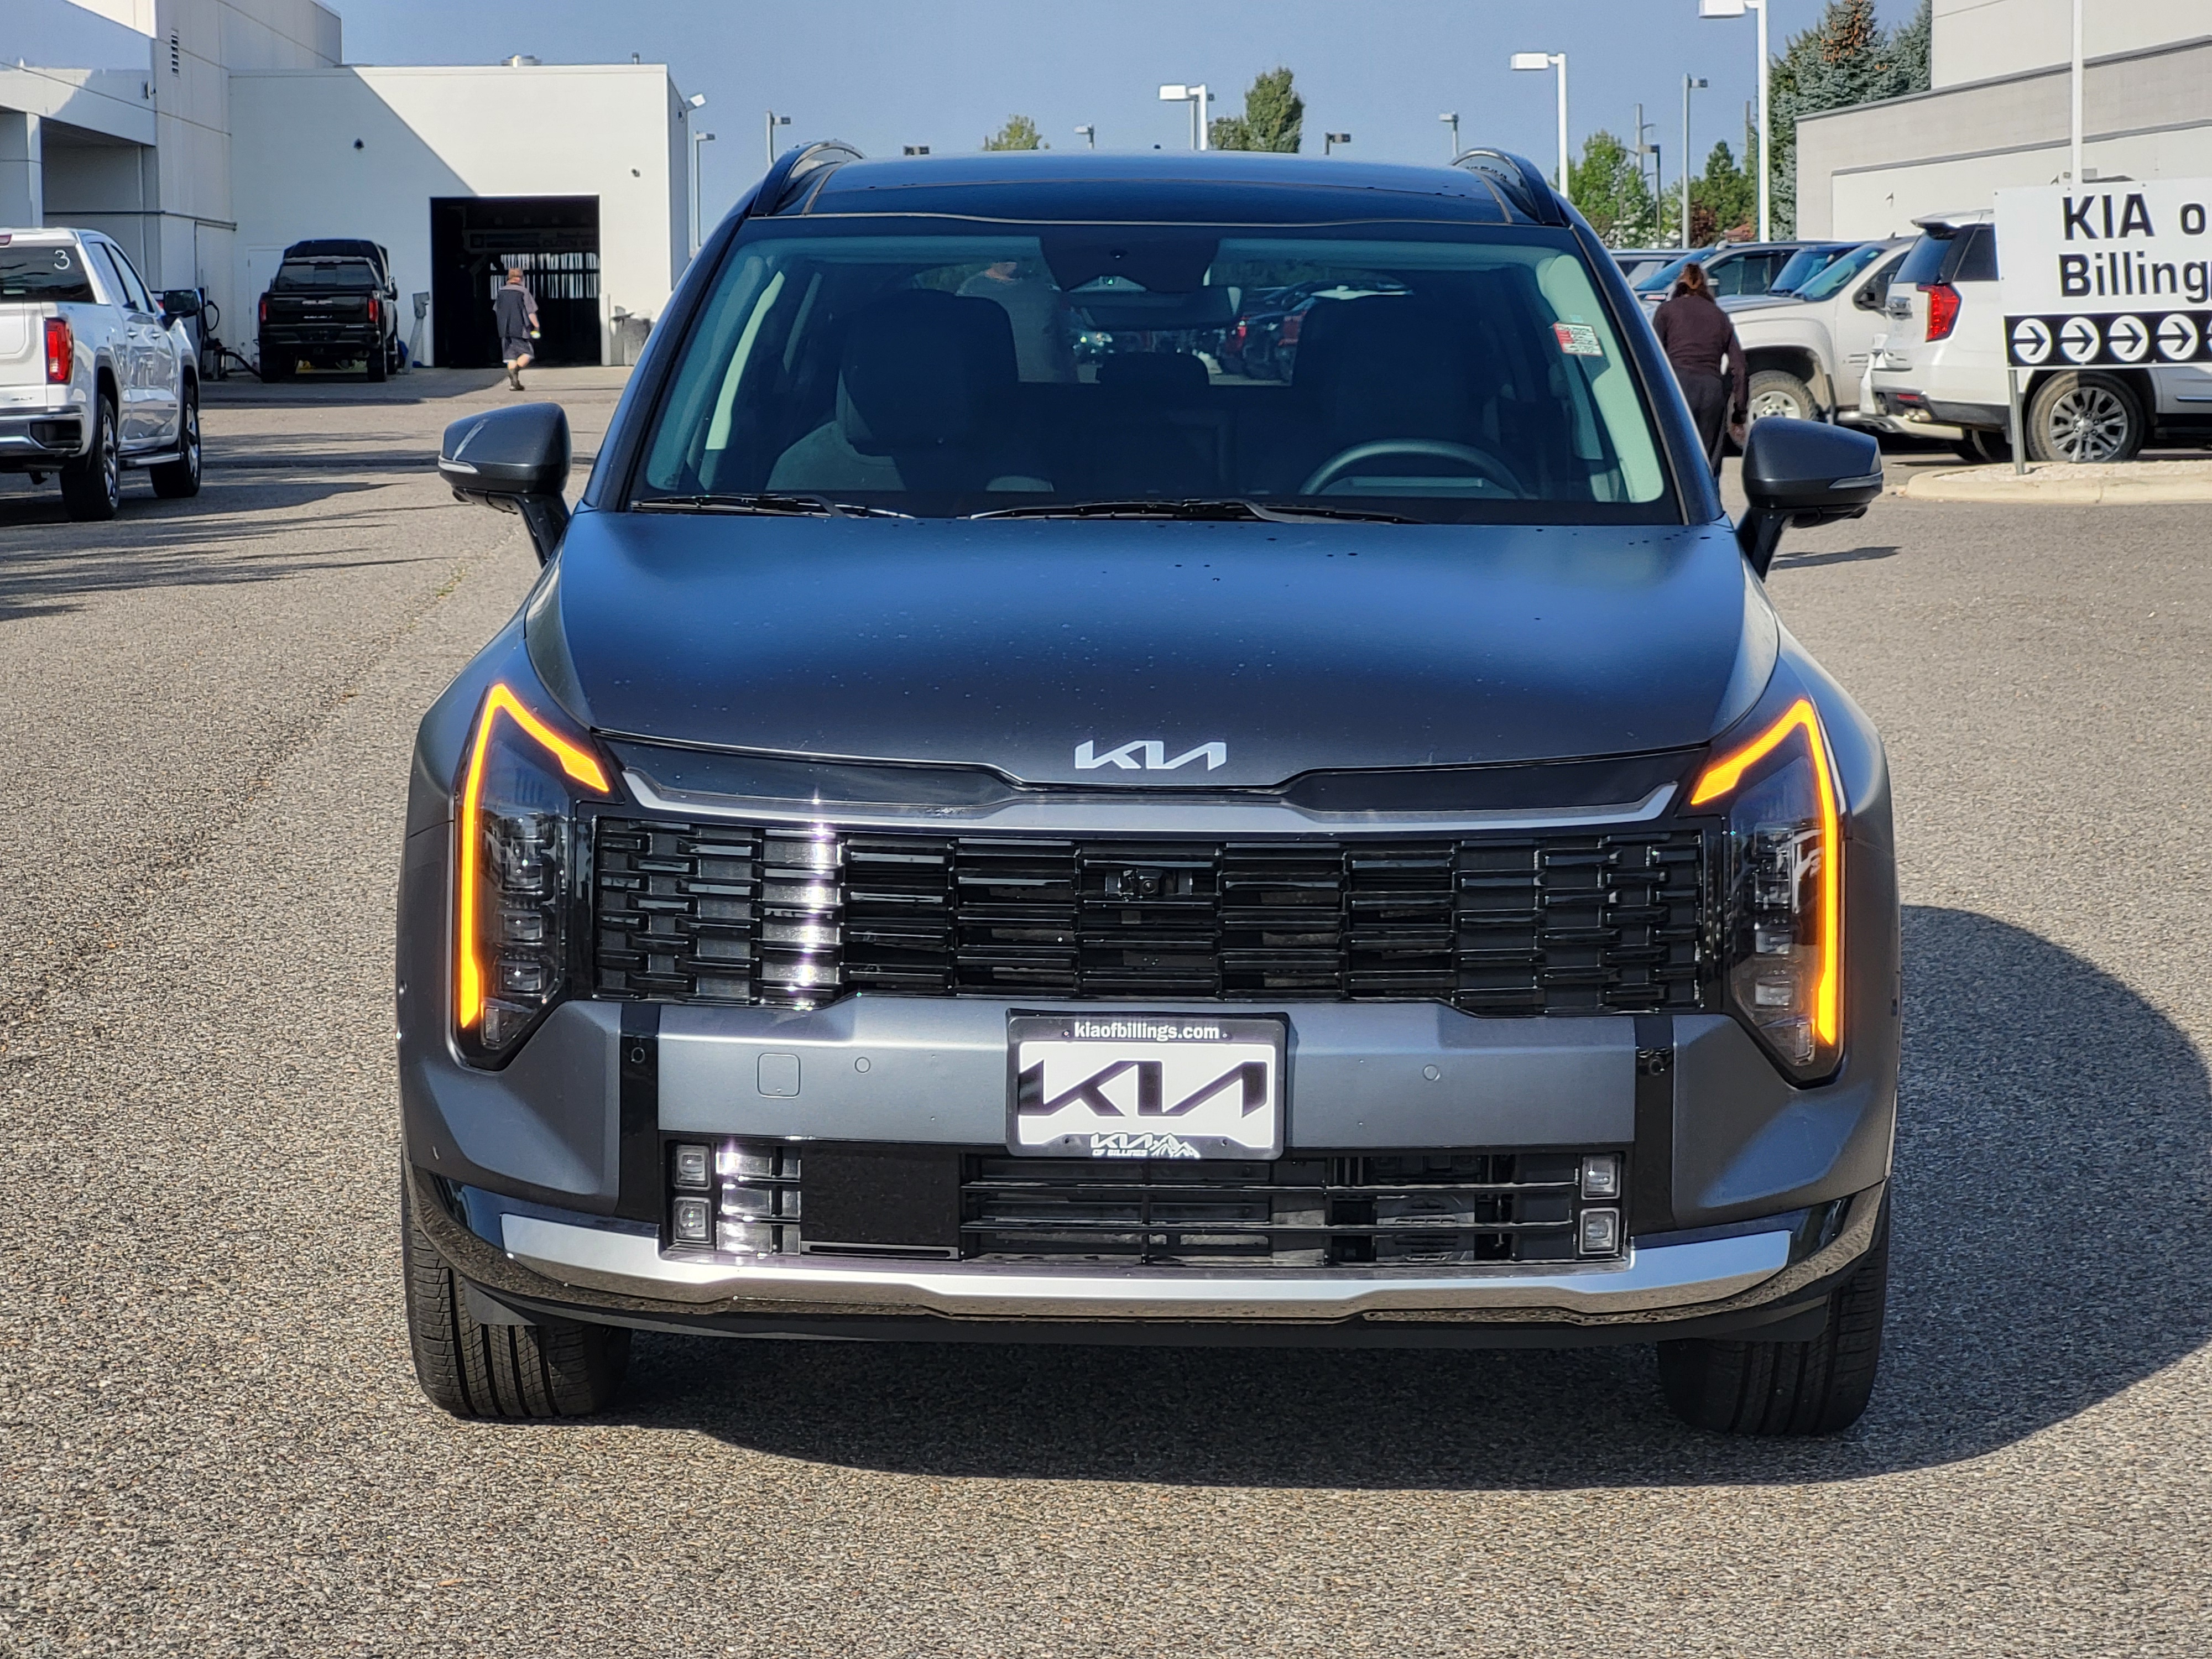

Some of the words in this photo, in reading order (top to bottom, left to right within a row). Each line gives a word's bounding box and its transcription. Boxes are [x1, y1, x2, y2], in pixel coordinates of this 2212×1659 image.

[2062, 193, 2155, 240] KIA
[2180, 203, 2206, 236] o
[54, 249, 70, 270] 3
[2058, 250, 2212, 304] Billing
[1074, 739, 1227, 771] KIA
[1074, 1021, 1220, 1041] kiaofbillings.com
[1019, 1059, 1268, 1118] KIA
[1091, 1133, 1154, 1149] KIA
